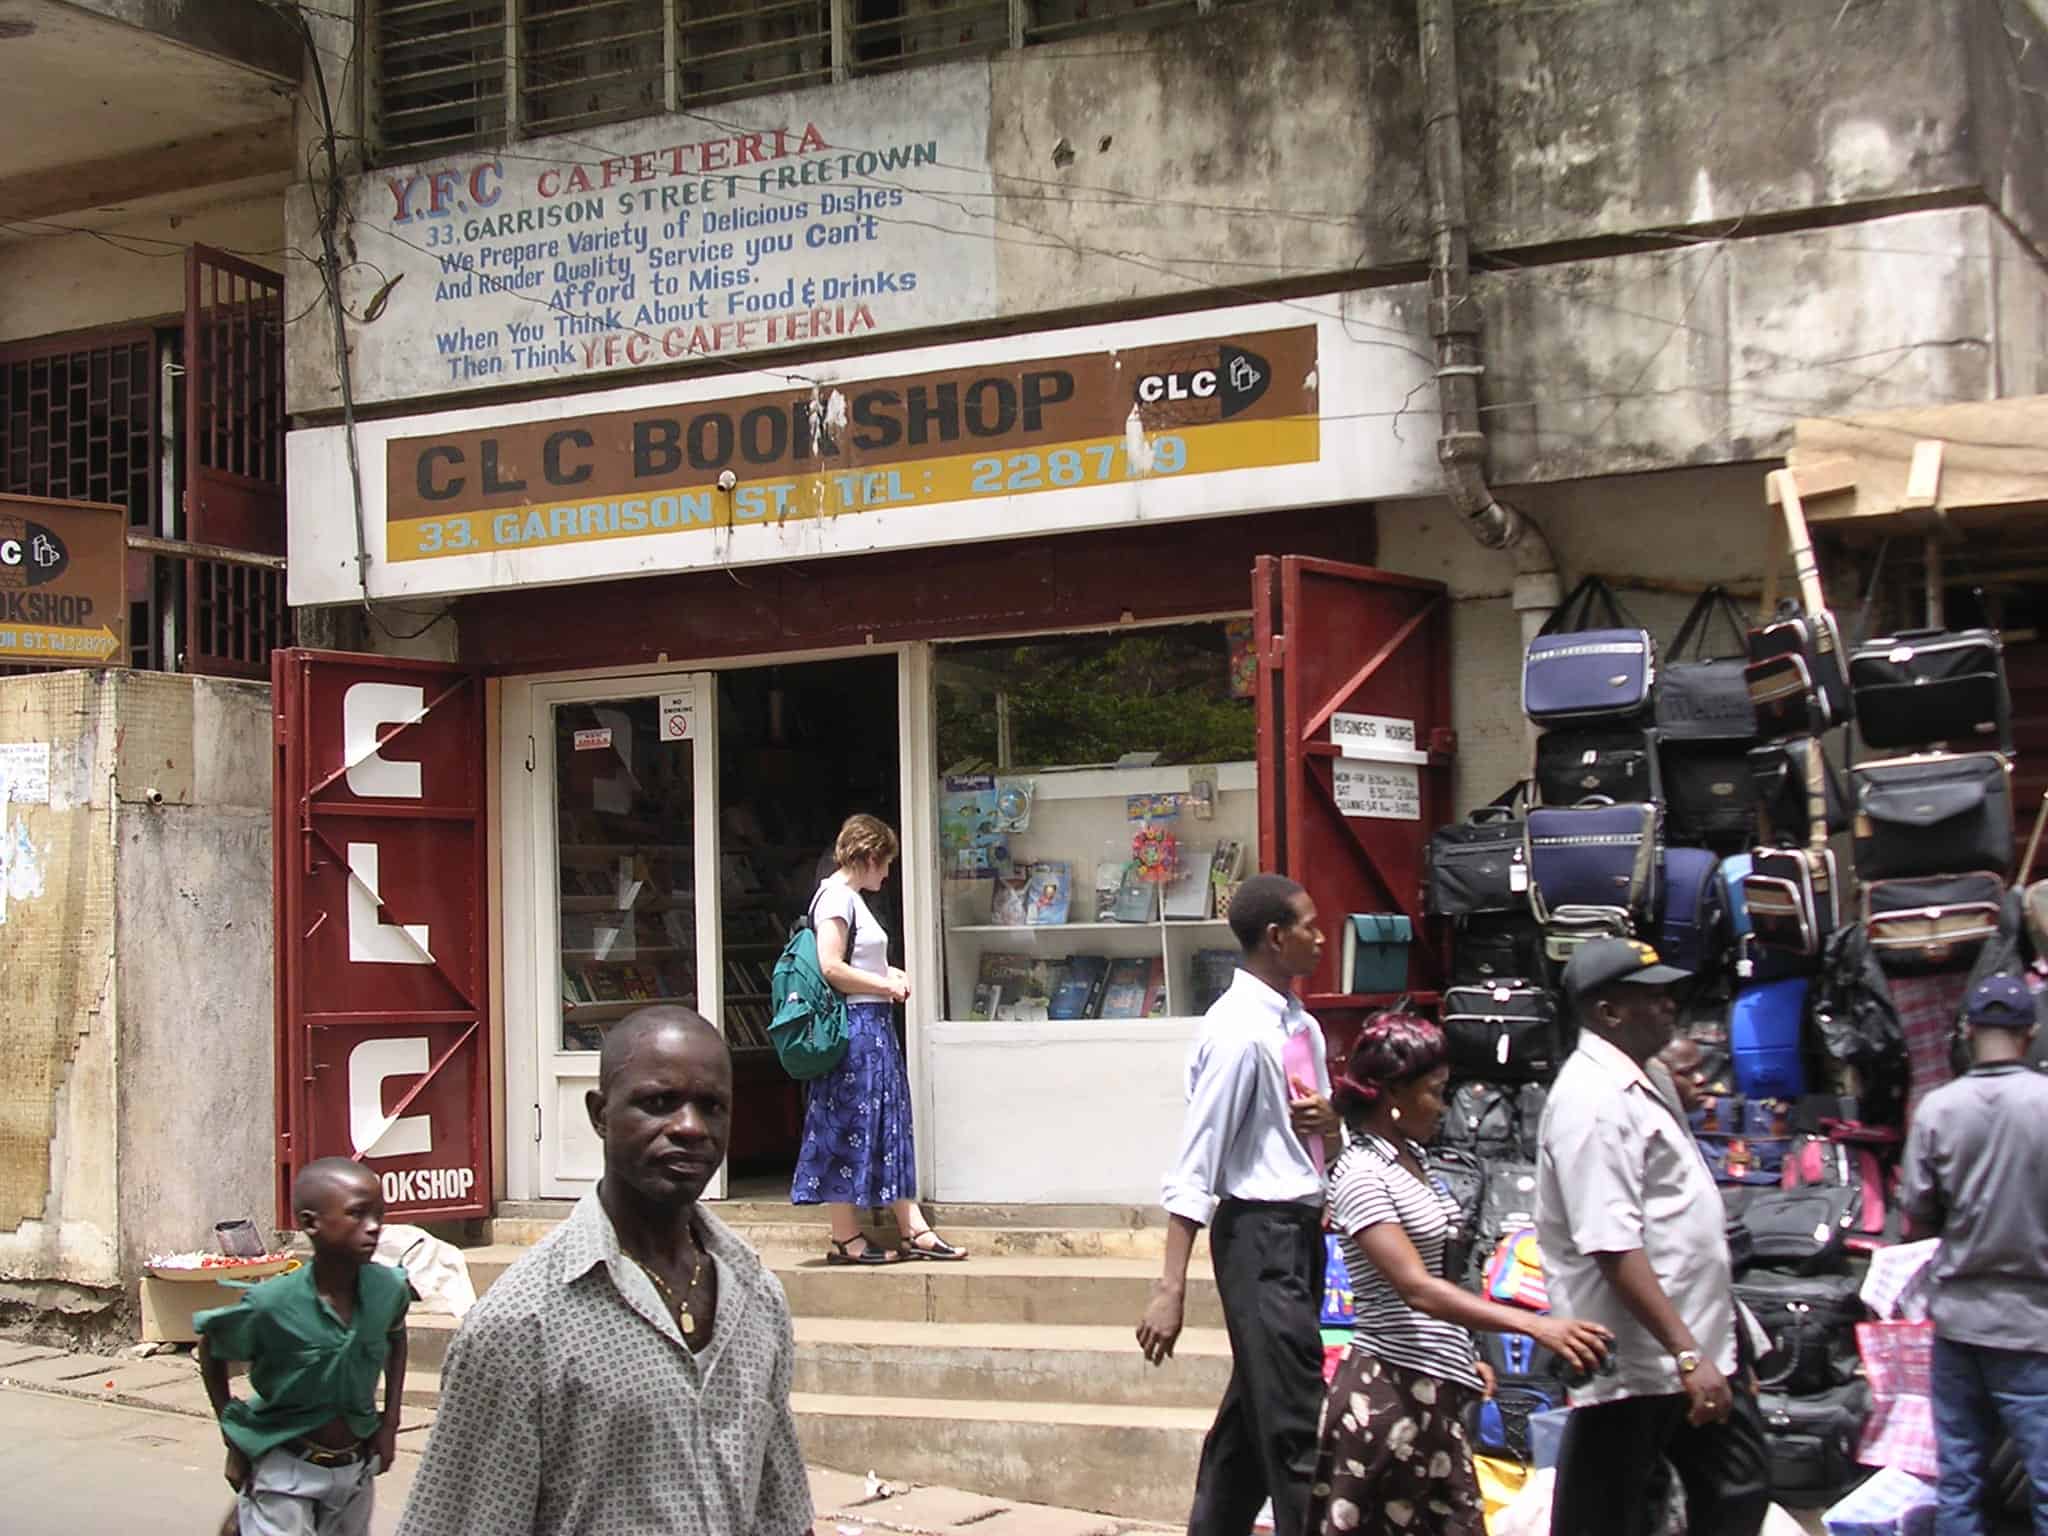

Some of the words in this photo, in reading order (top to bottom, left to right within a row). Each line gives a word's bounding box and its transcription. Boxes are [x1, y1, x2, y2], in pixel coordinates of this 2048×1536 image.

[463, 197, 604, 242] GARRISON
[618, 175, 738, 215] STREET
[759, 141, 937, 193] FREETOWN
[536, 122, 833, 199] CAFETERIA
[435, 278, 472, 303] And
[479, 266, 545, 295] Render
[553, 255, 632, 284] Quality
[648, 240, 734, 271] Service
[745, 233, 793, 266] you
[805, 214, 879, 249] Can't
[439, 252, 474, 275] We
[480, 238, 559, 272] Prepare
[567, 221, 648, 255] Variety
[663, 209, 690, 241] of
[702, 201, 809, 234] Delicious
[820, 187, 903, 217] Dishes
[436, 325, 498, 355] When
[506, 321, 544, 343] You
[553, 307, 623, 337] Think
[633, 294, 709, 327] About
[727, 277, 794, 316] Food
[822, 271, 917, 302] Drinks
[548, 274, 636, 311] Afford
[650, 270, 679, 296] to
[688, 264, 760, 293] Miss.
[447, 351, 502, 380] Then
[511, 340, 577, 371] Think
[662, 303, 877, 358] CAFETERIA
[1138, 367, 1218, 403] CLC
[633, 370, 1074, 479] BOOKSHOP
[418, 518, 479, 553] 33.
[493, 493, 713, 544] GARRISON
[735, 483, 798, 520] ST.
[374, 1167, 474, 1204] OKSHOP
